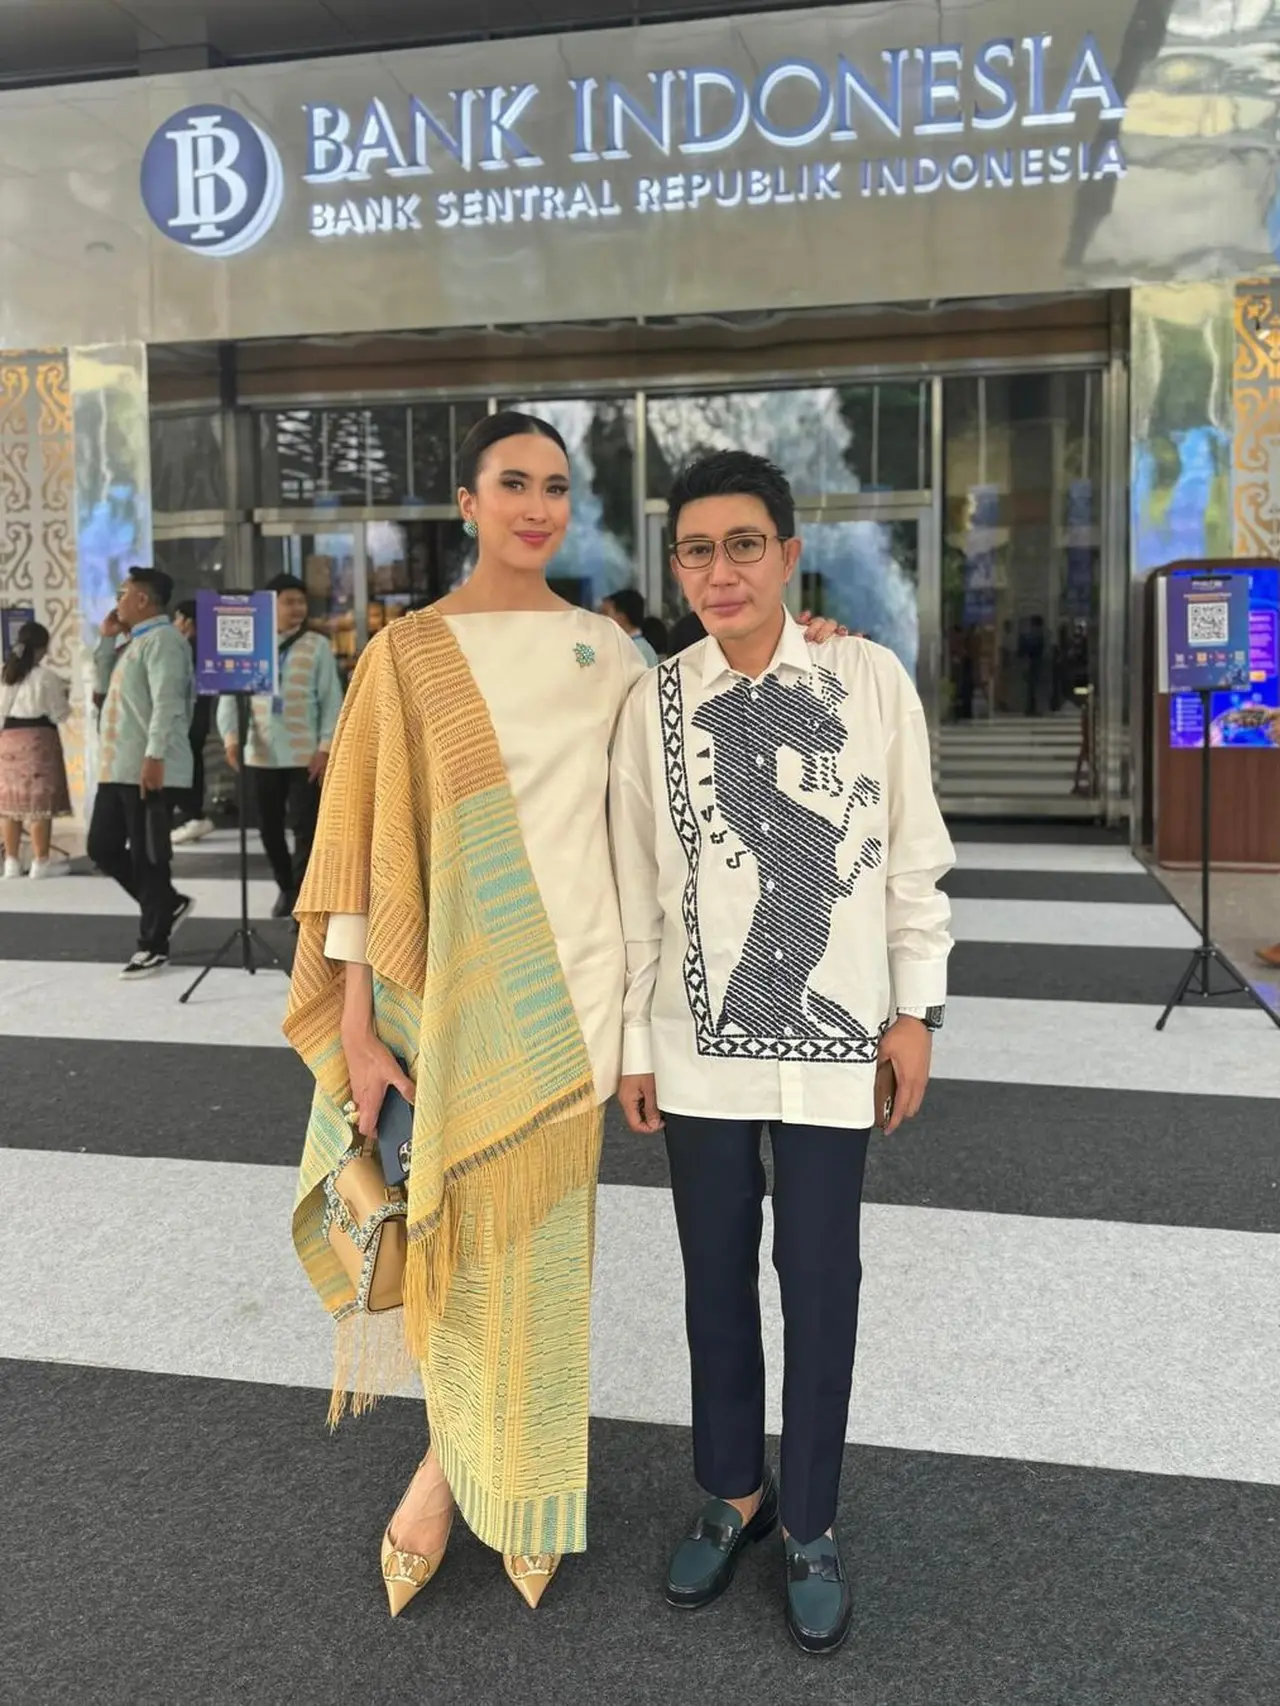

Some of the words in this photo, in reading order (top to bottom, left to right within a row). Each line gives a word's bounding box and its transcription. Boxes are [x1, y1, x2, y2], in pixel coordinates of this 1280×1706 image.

[301, 84, 544, 183] BANK
[569, 30, 1128, 162] INDONESIA
[309, 194, 422, 237] BANK
[436, 179, 622, 227] SENTRAL
[636, 162, 842, 213] REPUBLIK
[861, 138, 1129, 197] INDONESIA
